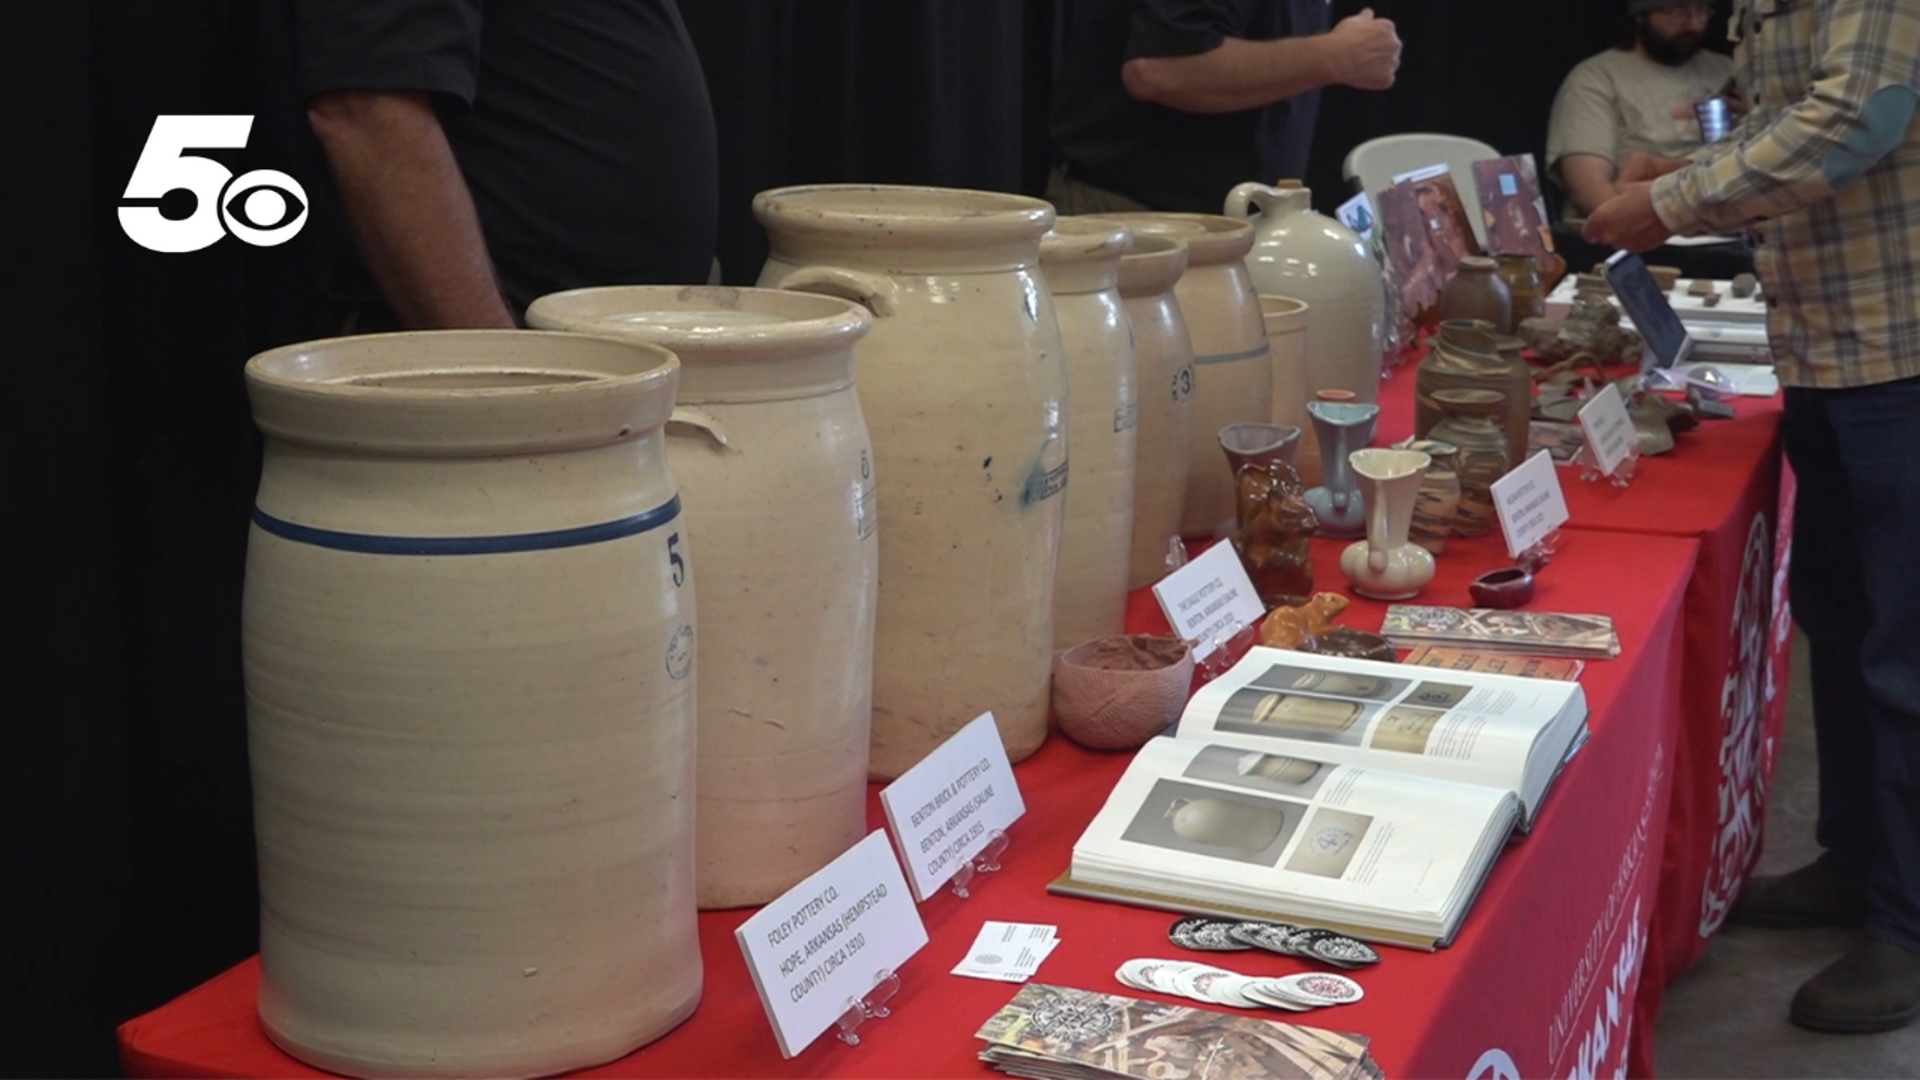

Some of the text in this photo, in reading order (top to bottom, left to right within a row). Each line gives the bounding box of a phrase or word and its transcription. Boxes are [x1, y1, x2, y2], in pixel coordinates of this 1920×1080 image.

[1181, 369, 1191, 395] 3
[667, 532, 684, 588] 5
[910, 800, 936, 829] BENTON
[933, 788, 953, 809] BRICK
[955, 764, 981, 791] POTTERY
[945, 800, 975, 831] ARKANSAS
[972, 784, 995, 812] (SALINE
[928, 845, 955, 876] COUNTY)
[952, 832, 971, 855] CIRCA
[766, 886, 839, 948] FOLEY POTTERY CO.
[780, 883, 888, 978] HOPE, ARKANSAS (HEMPSTEAD
[790, 965, 826, 1003] COUNTY)
[823, 948, 848, 975] CIRCA
[1549, 919, 1602, 1065] UNIVERSITY
